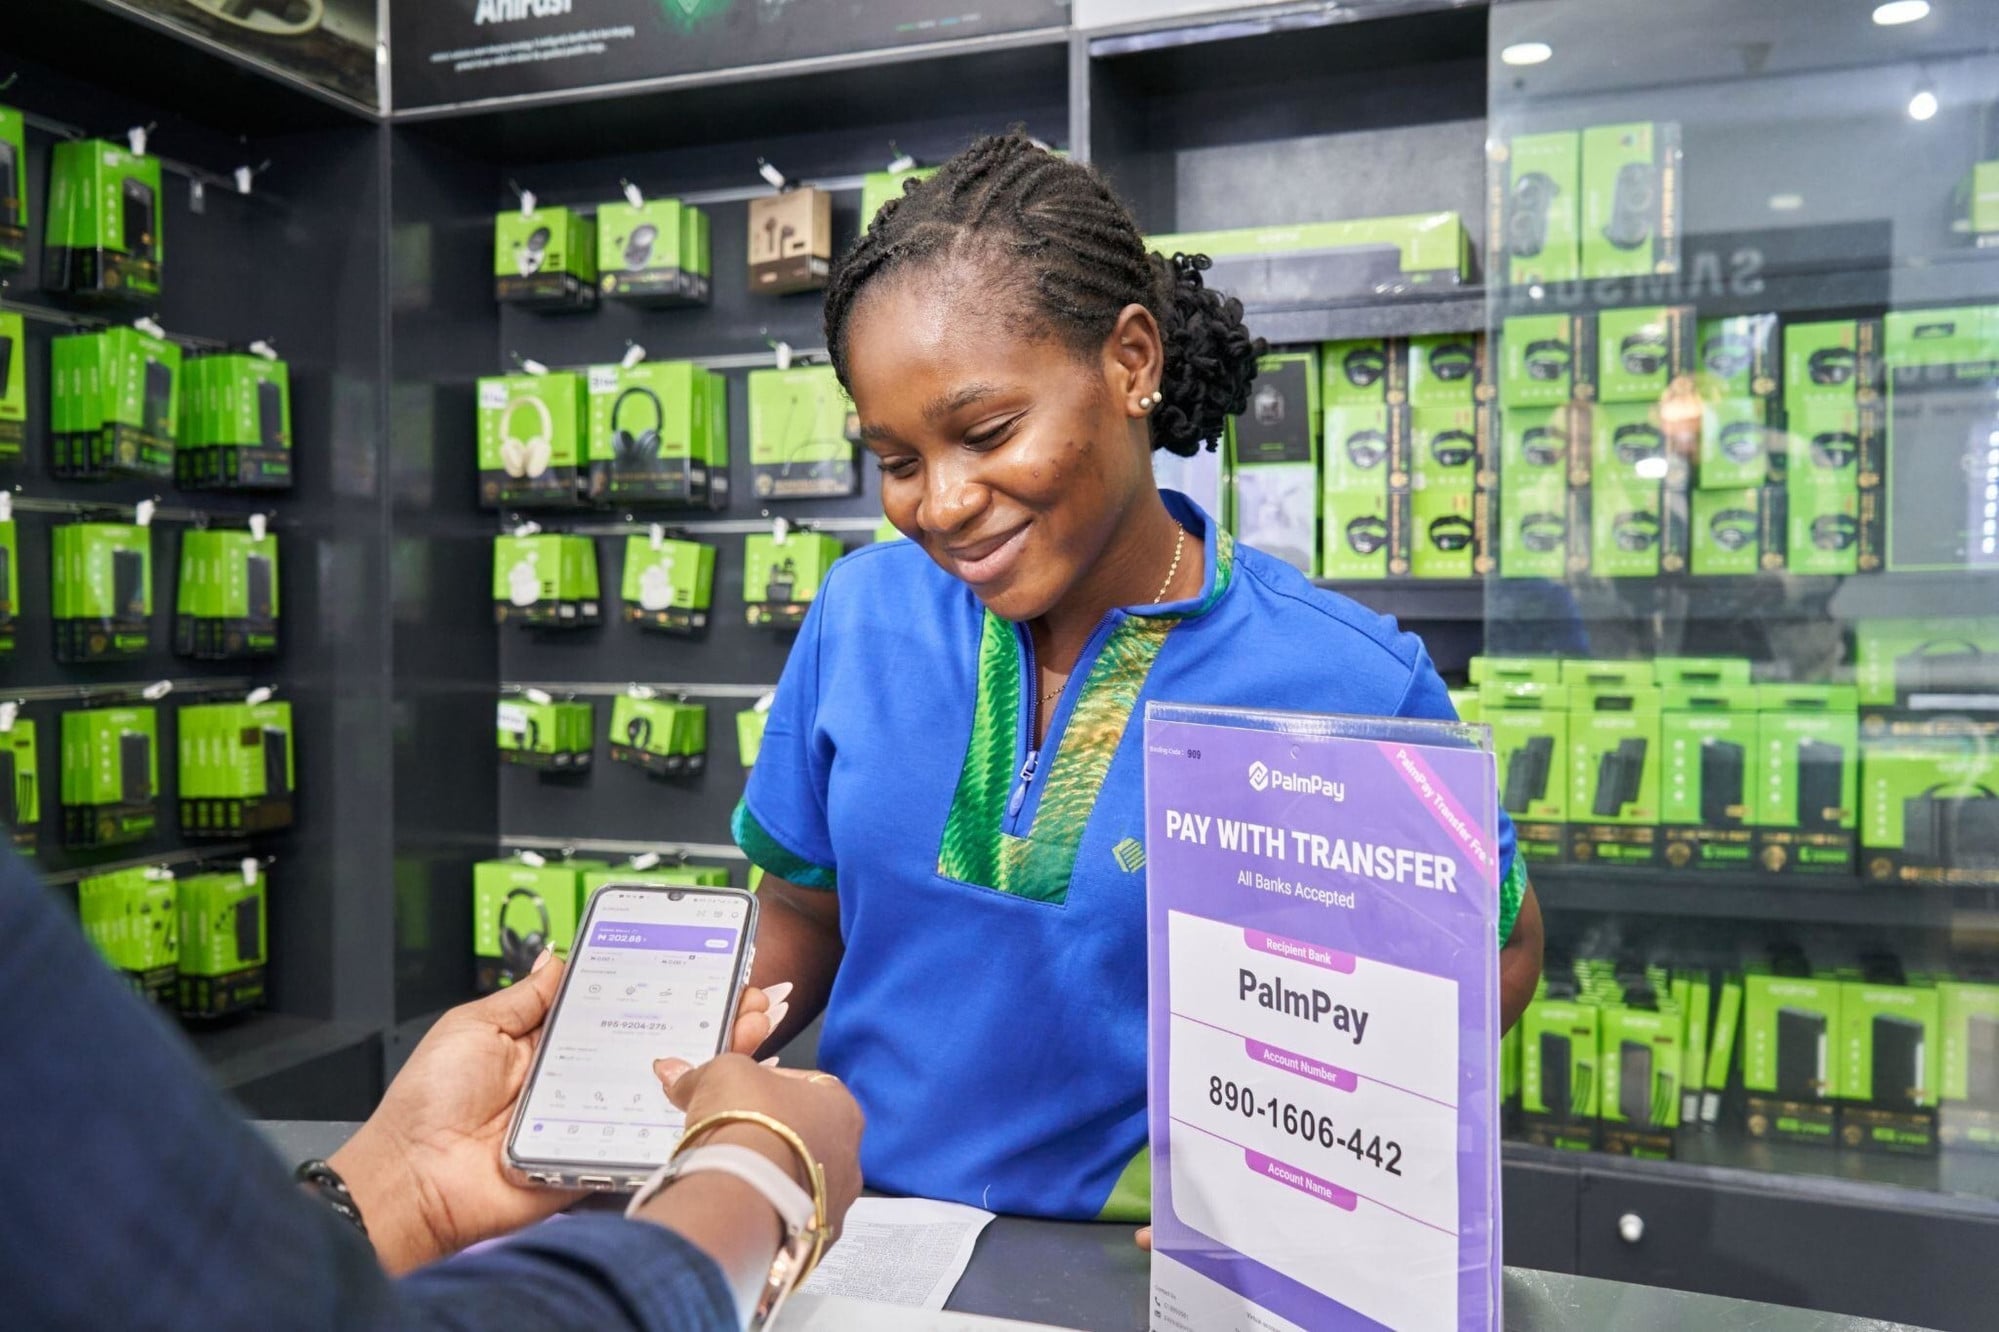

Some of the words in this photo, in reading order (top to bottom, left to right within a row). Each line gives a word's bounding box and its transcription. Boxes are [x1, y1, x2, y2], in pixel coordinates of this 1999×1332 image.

[1272, 770, 1345, 802] PalmPay
[1397, 748, 1434, 798] PalmPay
[1433, 793, 1472, 841] Transfer
[1166, 810, 1212, 845] PAY
[1217, 818, 1285, 860] WITH
[1292, 831, 1457, 893] TRANSFER
[1237, 870, 1253, 887] All
[1255, 873, 1292, 896] Banks
[1295, 882, 1355, 909] Accepted
[1266, 938, 1307, 959] Recipient
[1309, 950, 1332, 965] Bank
[1239, 968, 1368, 1045] PalmPay
[1263, 1048, 1300, 1070] Account
[1301, 1060, 1337, 1083] Number
[1209, 1075, 1402, 1176] 890-1606-442
[1268, 1162, 1304, 1186] Account
[1305, 1177, 1332, 1199] Name
